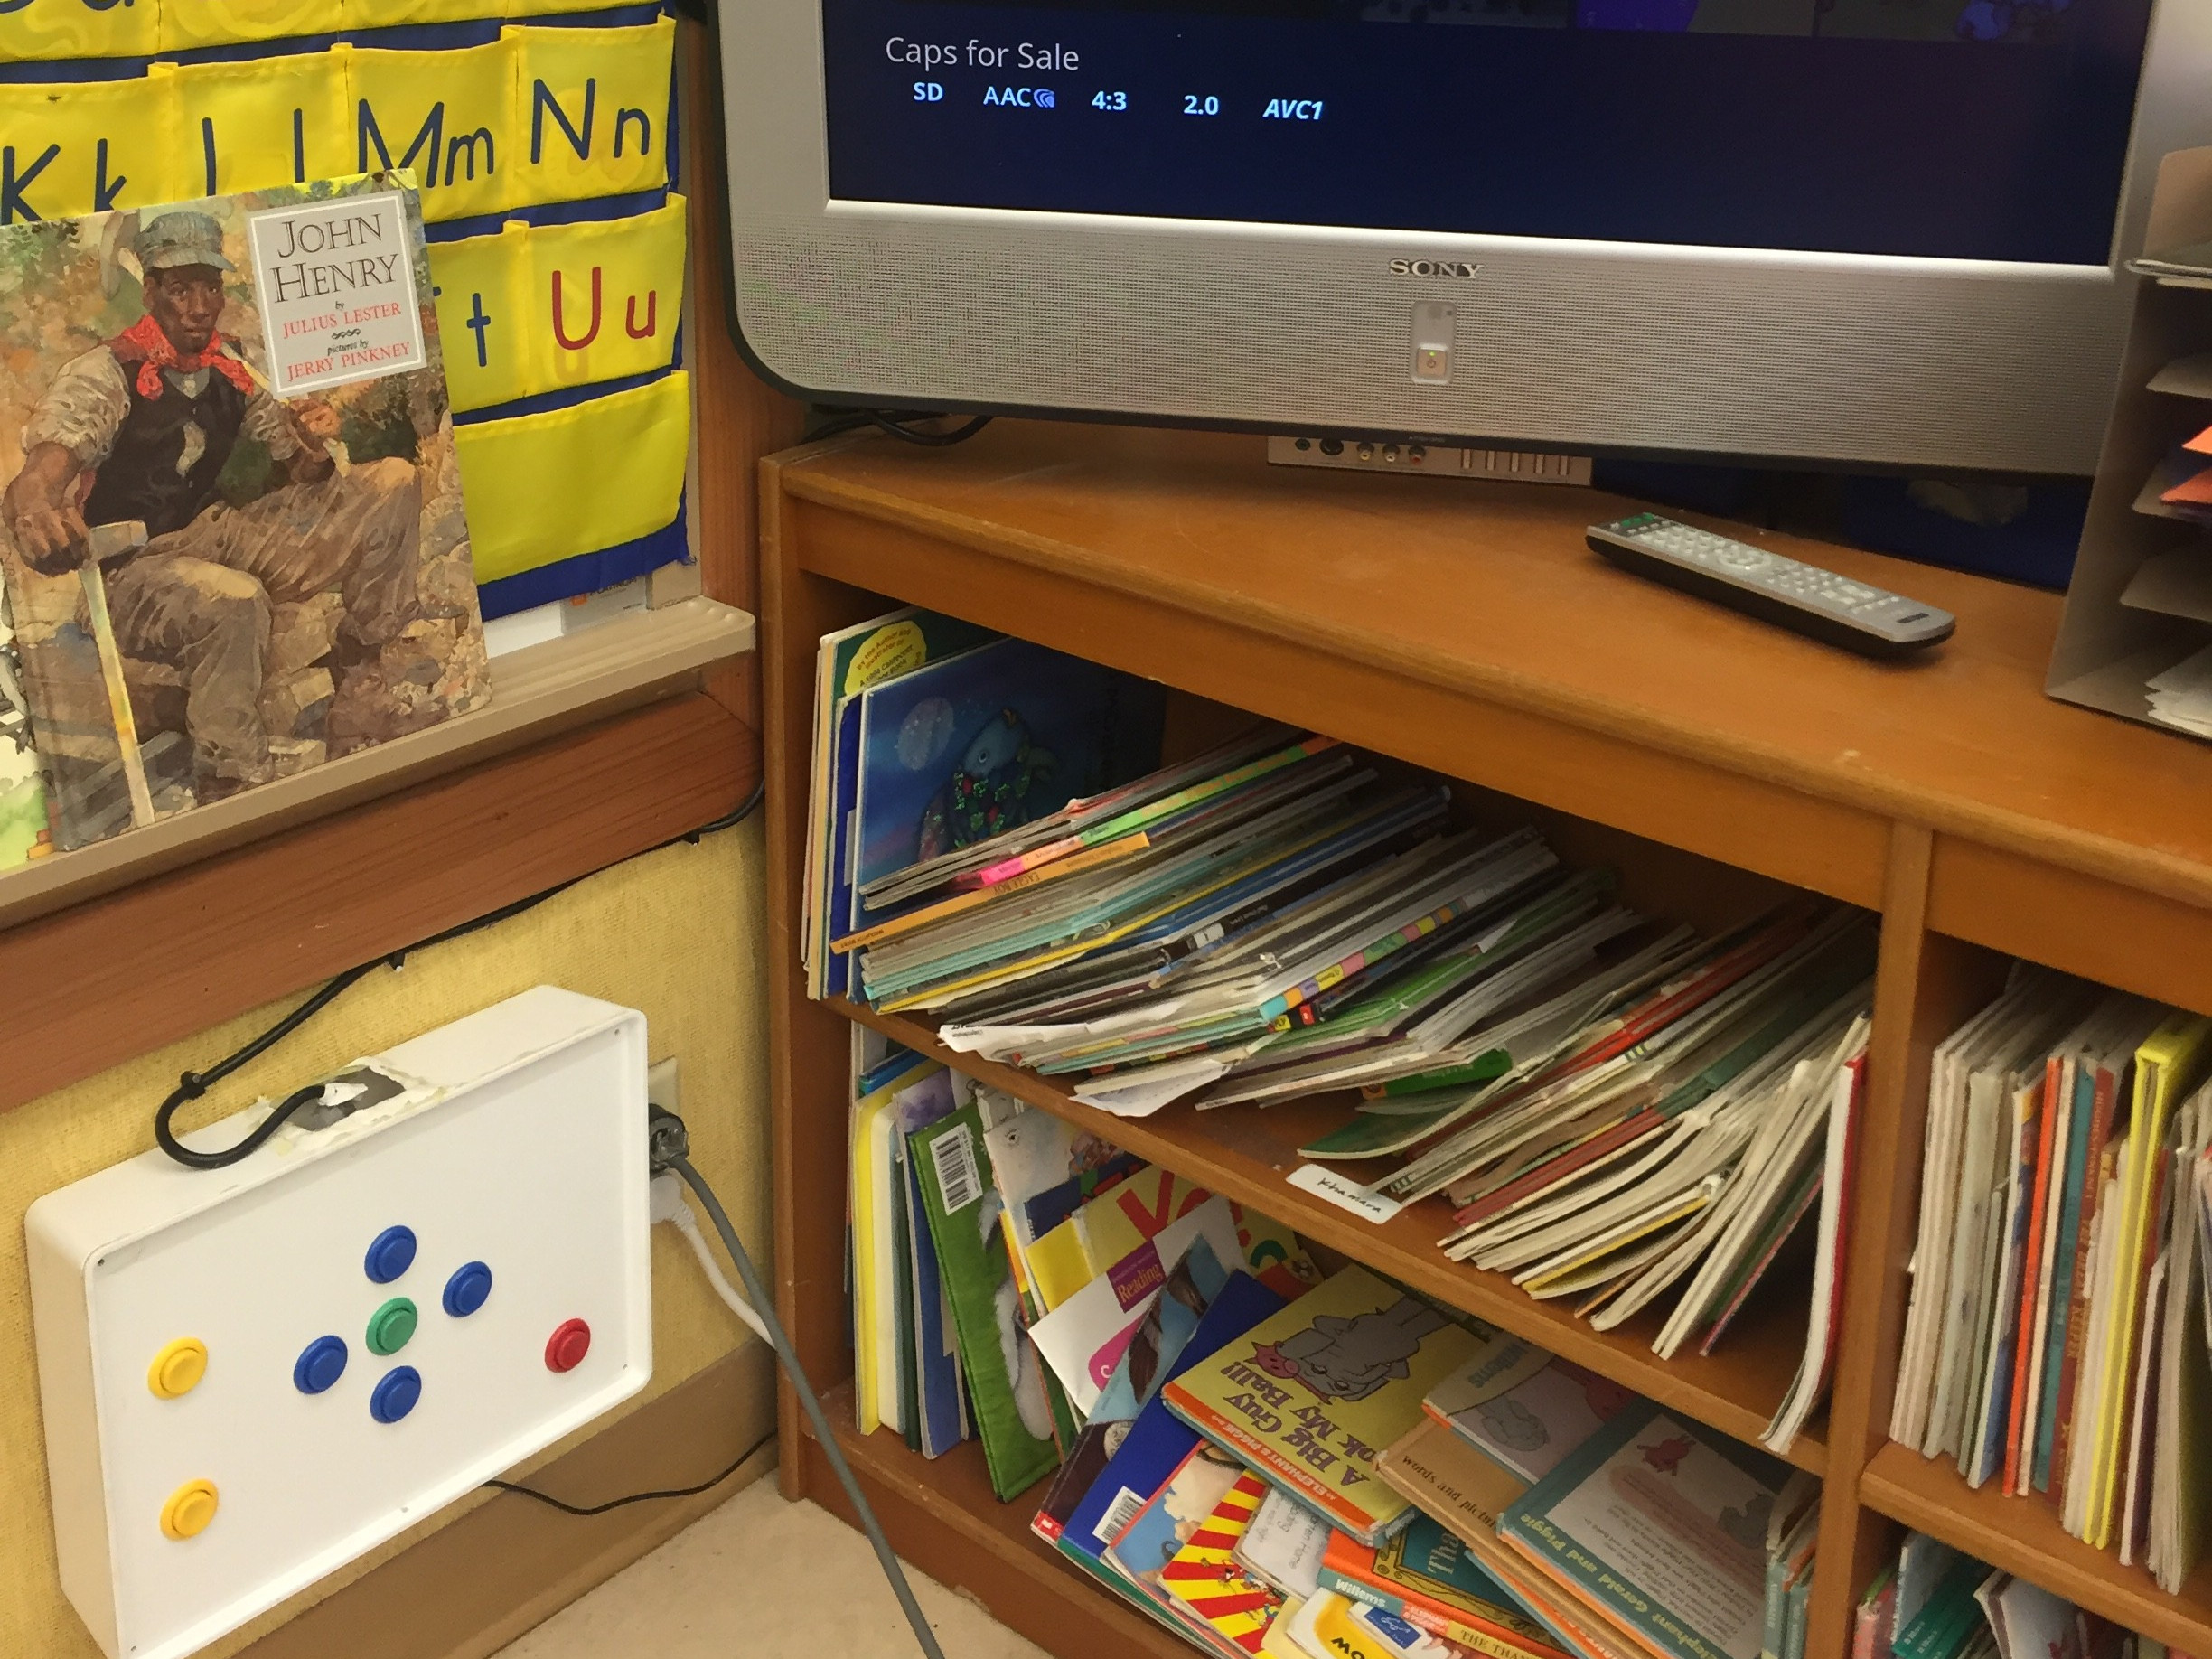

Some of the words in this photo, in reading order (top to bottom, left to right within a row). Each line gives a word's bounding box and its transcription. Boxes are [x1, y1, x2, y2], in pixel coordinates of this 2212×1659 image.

[886, 36, 958, 72] Caps
[966, 39, 1009, 68] for
[1017, 42, 1080, 70] Sale
[913, 81, 943, 102] SD
[983, 86, 1032, 107] AAC
[1091, 90, 1127, 111] 4:3
[1183, 95, 1220, 116] 2.0
[1262, 98, 1324, 120] AVC1
[277, 212, 382, 258] JOHN
[270, 253, 399, 304] HENRY
[1389, 258, 1485, 279] SONY
[282, 314, 338, 340] JULIUS
[343, 301, 402, 325] LESTER
[334, 300, 345, 311] by
[286, 357, 335, 382] JERRY
[340, 341, 410, 369] PINKNEY
[359, 339, 370, 350] by
[1116, 1265, 1164, 1304] Reading
[1220, 1361, 1295, 1411] Ball!
[1222, 1392, 1283, 1433] Guy
[1289, 1405, 1342, 1442] My
[1223, 1421, 1261, 1451] PIGGIE
[1279, 1426, 1341, 1473] Big
[1269, 1451, 1326, 1496] ELEPHANT
[1339, 1464, 1371, 1487] A
[1401, 1455, 1437, 1484] words
[1437, 1483, 1463, 1502] and
[1519, 1513, 1566, 1551] Piggie
[1565, 1549, 1598, 1574] and
[1335, 1578, 1387, 1609] Willems
[1598, 1573, 1649, 1614] Gerald
[1460, 1628, 1489, 1649] THE
